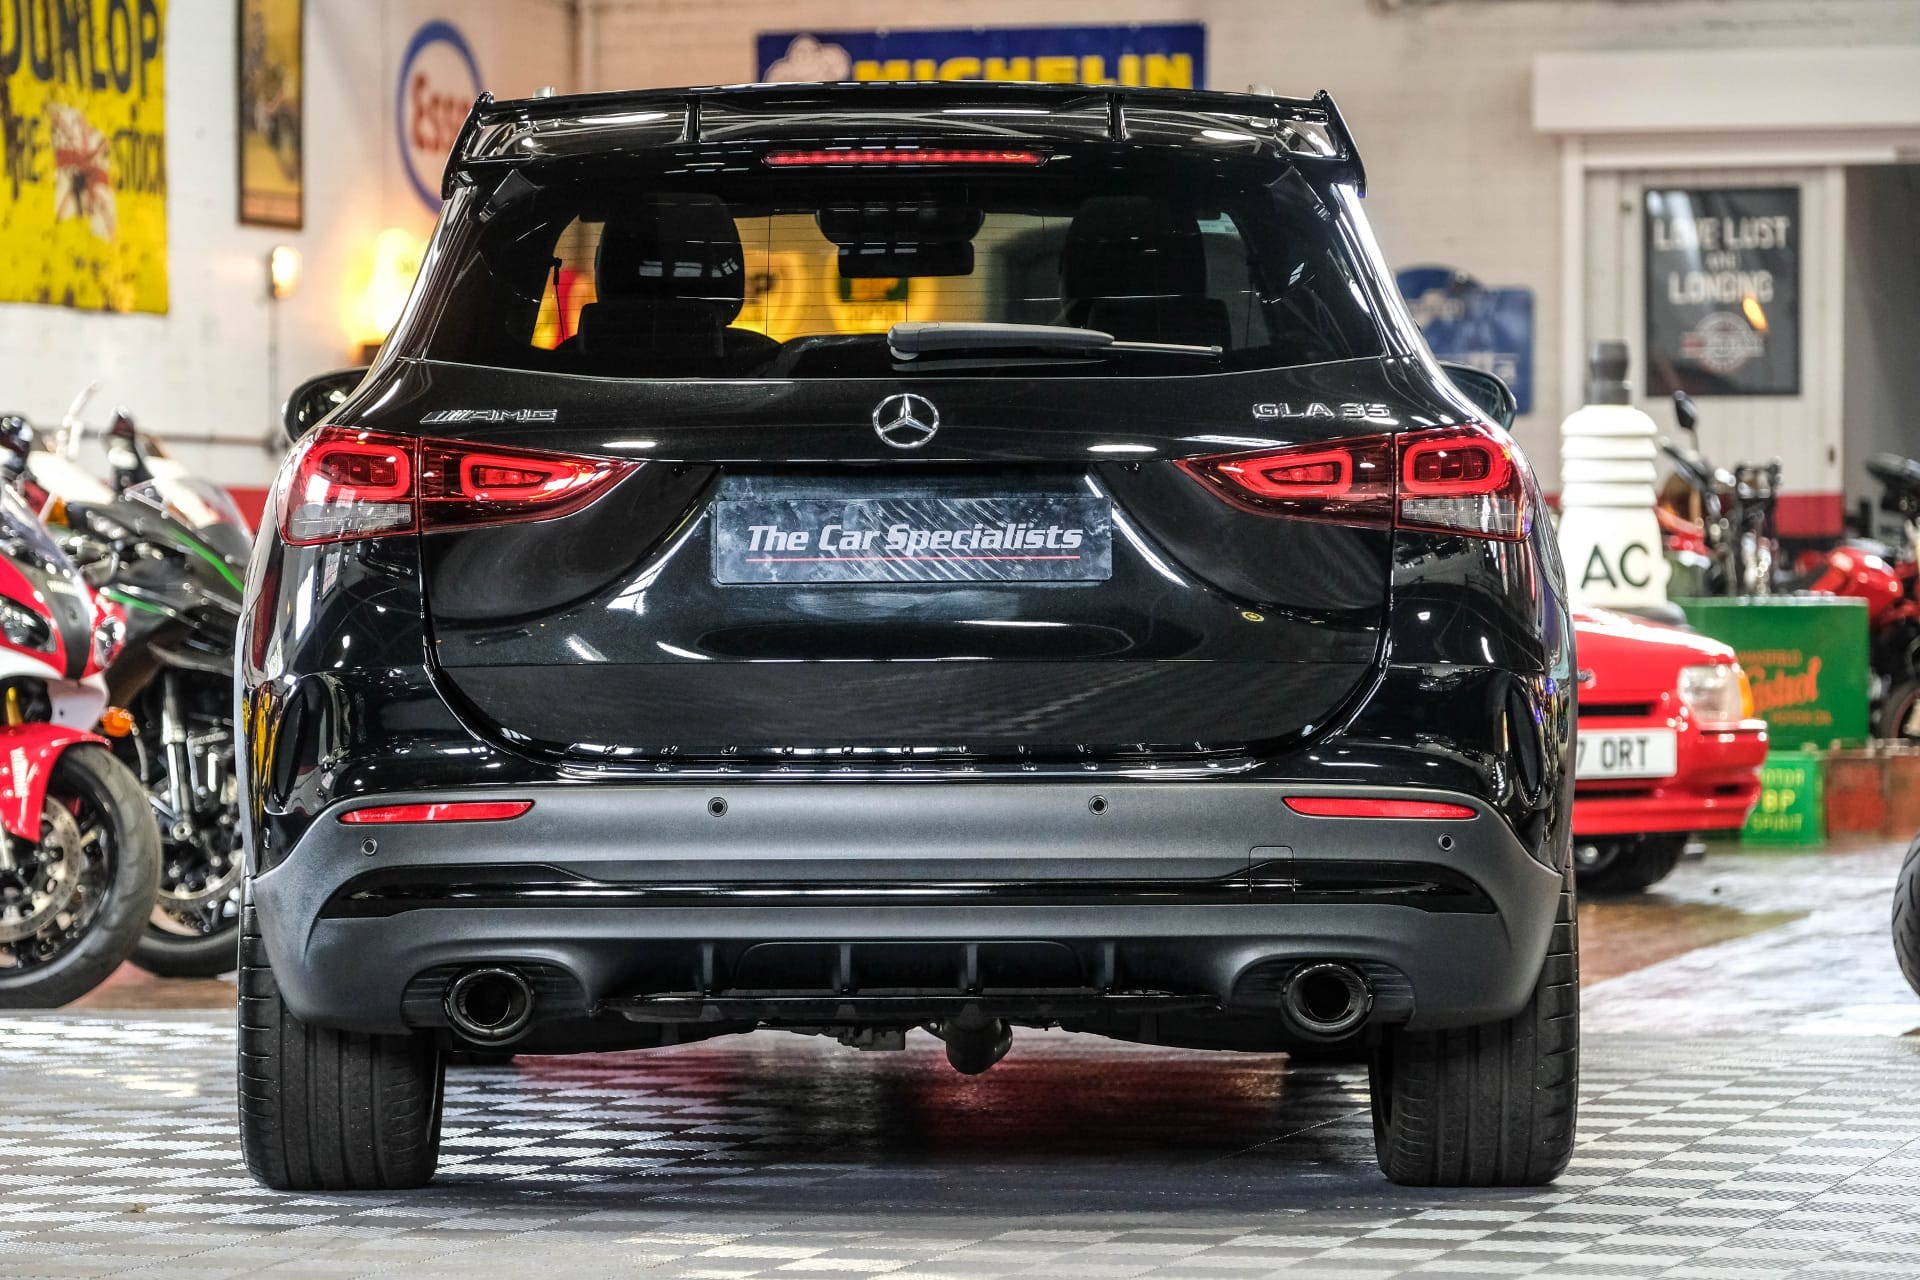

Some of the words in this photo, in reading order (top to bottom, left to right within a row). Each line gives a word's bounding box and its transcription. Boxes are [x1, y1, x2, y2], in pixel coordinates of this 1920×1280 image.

[854, 52, 1193, 89] MICHELIN
[1723, 215, 1791, 249] LUST
[1252, 402, 1335, 419] GLA
[1340, 402, 1391, 419] 35
[746, 524, 809, 552] The
[817, 524, 881, 552] Car
[884, 522, 1084, 556] Specialists
[1580, 543, 1652, 590] AC
[1601, 736, 1650, 770] ORT
